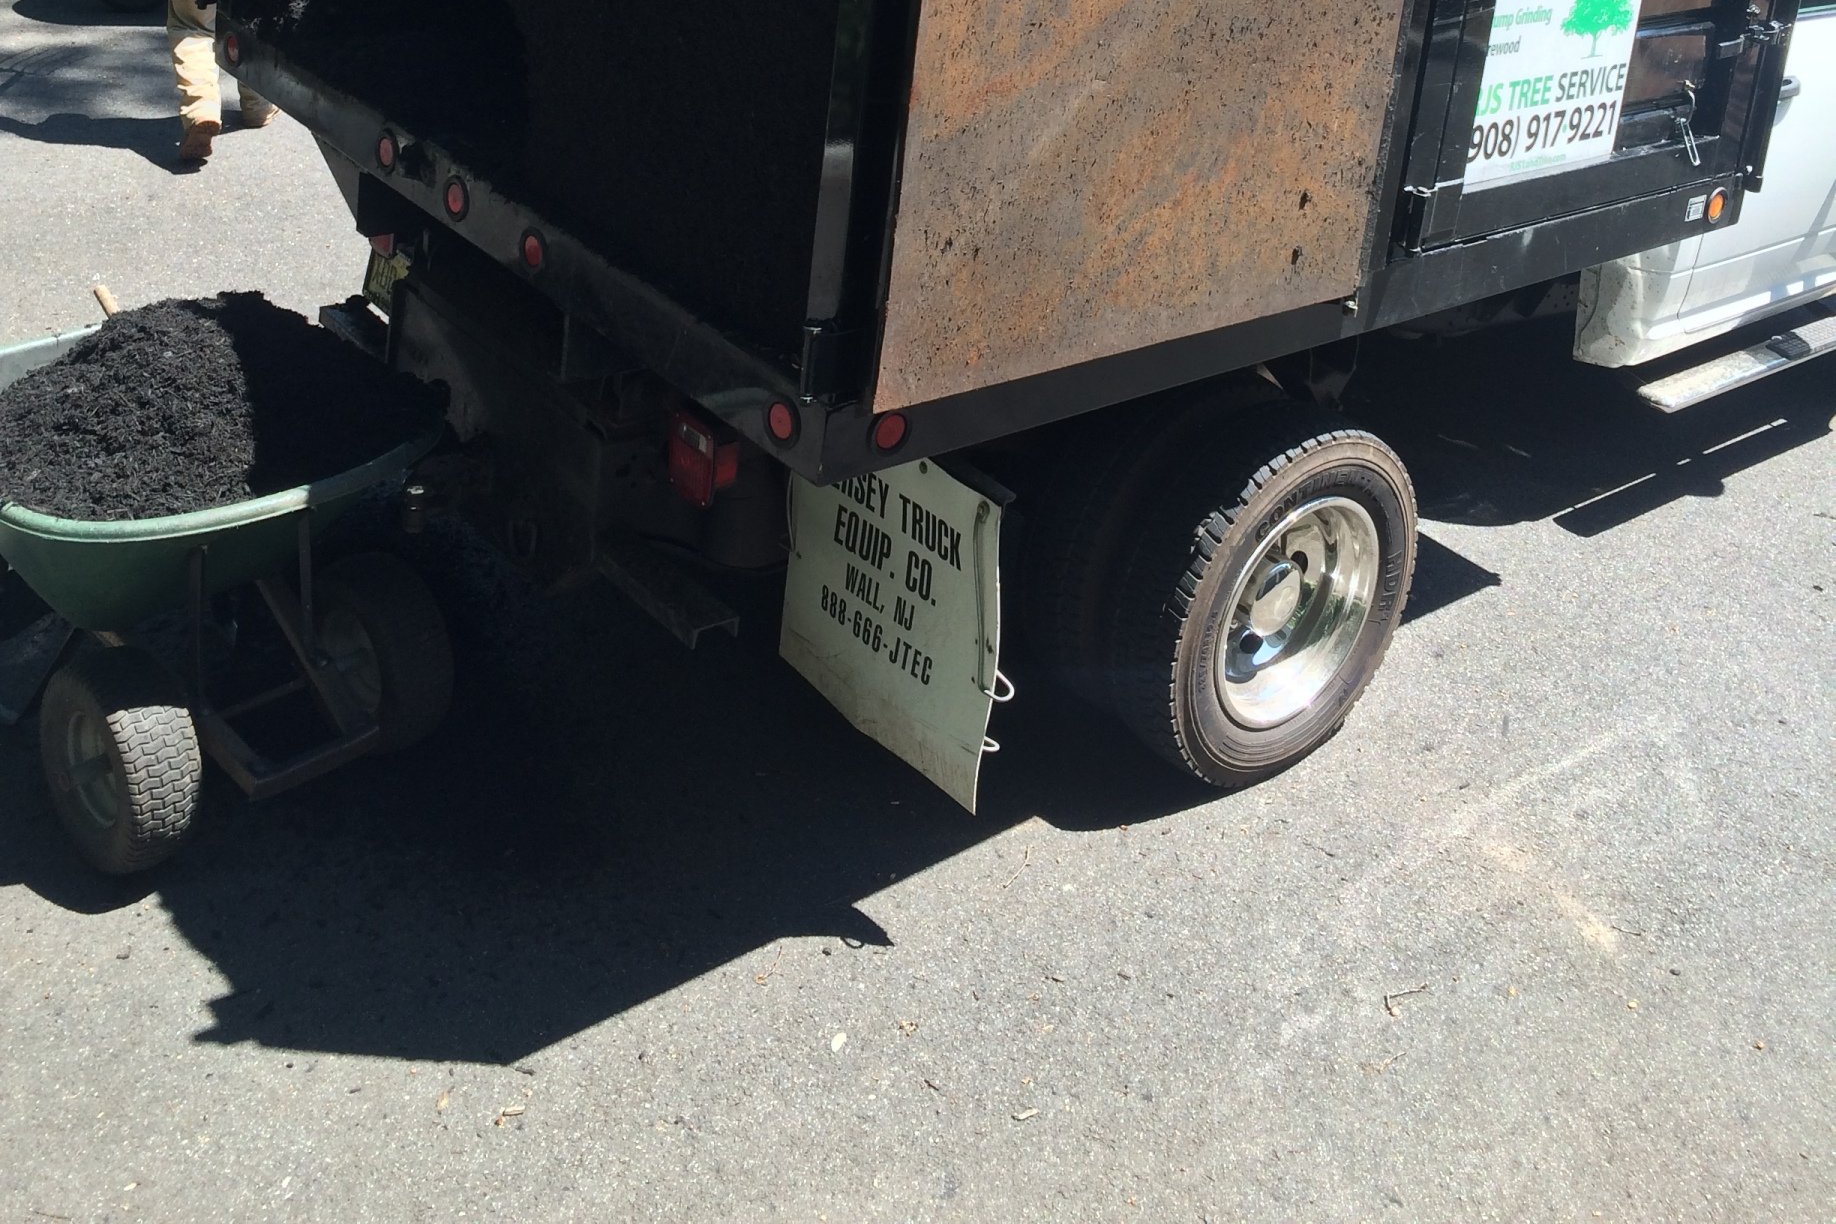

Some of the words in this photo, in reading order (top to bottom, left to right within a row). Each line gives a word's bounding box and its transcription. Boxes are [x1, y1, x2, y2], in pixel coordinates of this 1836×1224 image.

[1493, 13, 1514, 31] ump
[1515, 5, 1552, 26] Grinding
[1487, 36, 1521, 56] rewood
[1508, 75, 1554, 111] TREE
[1555, 63, 1627, 103] SERVICE
[1467, 115, 1520, 164] 908)
[899, 492, 961, 571] TRUCK
[845, 562, 885, 614] WALL,
[893, 595, 915, 631] NJ
[905, 550, 936, 607] CO.
[821, 584, 932, 685] 888-666-JTEC
